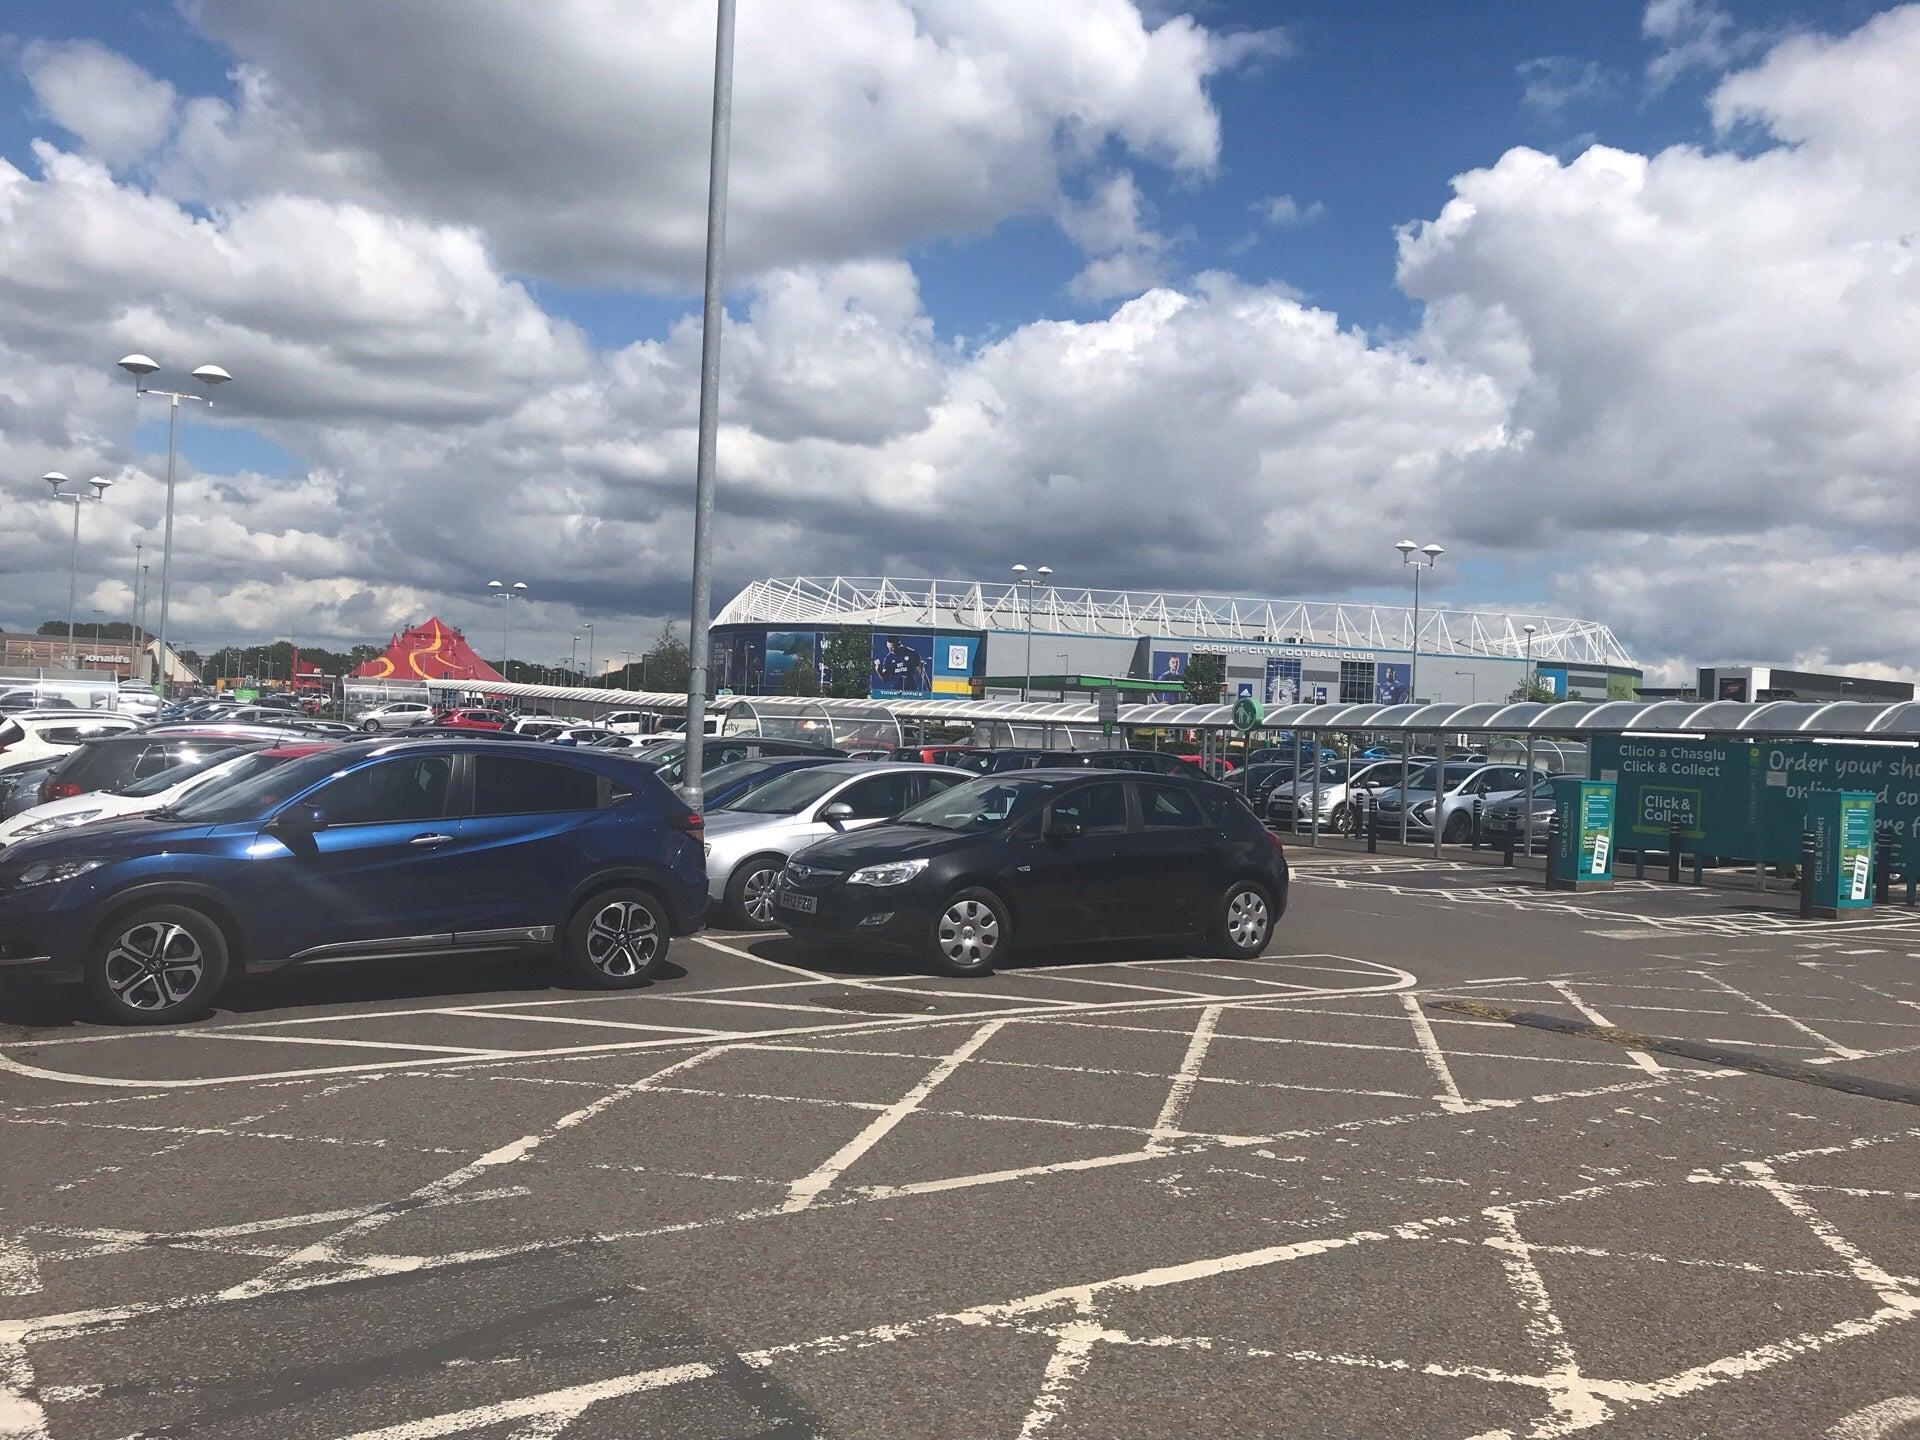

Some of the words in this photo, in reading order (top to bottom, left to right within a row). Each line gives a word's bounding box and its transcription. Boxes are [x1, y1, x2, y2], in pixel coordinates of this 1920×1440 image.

[1193, 644, 1247, 654] CARDIFF
[1249, 647, 1277, 657] CITY
[1278, 648, 1341, 660] FOOTBALL
[1343, 652, 1375, 661] CLUB
[1619, 745, 1656, 758] Clicio
[1659, 749, 1667, 758] a
[1671, 747, 1726, 762] Chasglu
[1623, 760, 1655, 773] Click
[1658, 762, 1668, 773] &
[1671, 763, 1721, 777] Collect
[1769, 750, 1829, 773] Order
[1835, 759, 1882, 779] your
[1645, 795, 1680, 810] Click
[1681, 798, 1691, 810] &
[1815, 816, 1825, 848] Collect
[1814, 859, 1824, 882] Click
